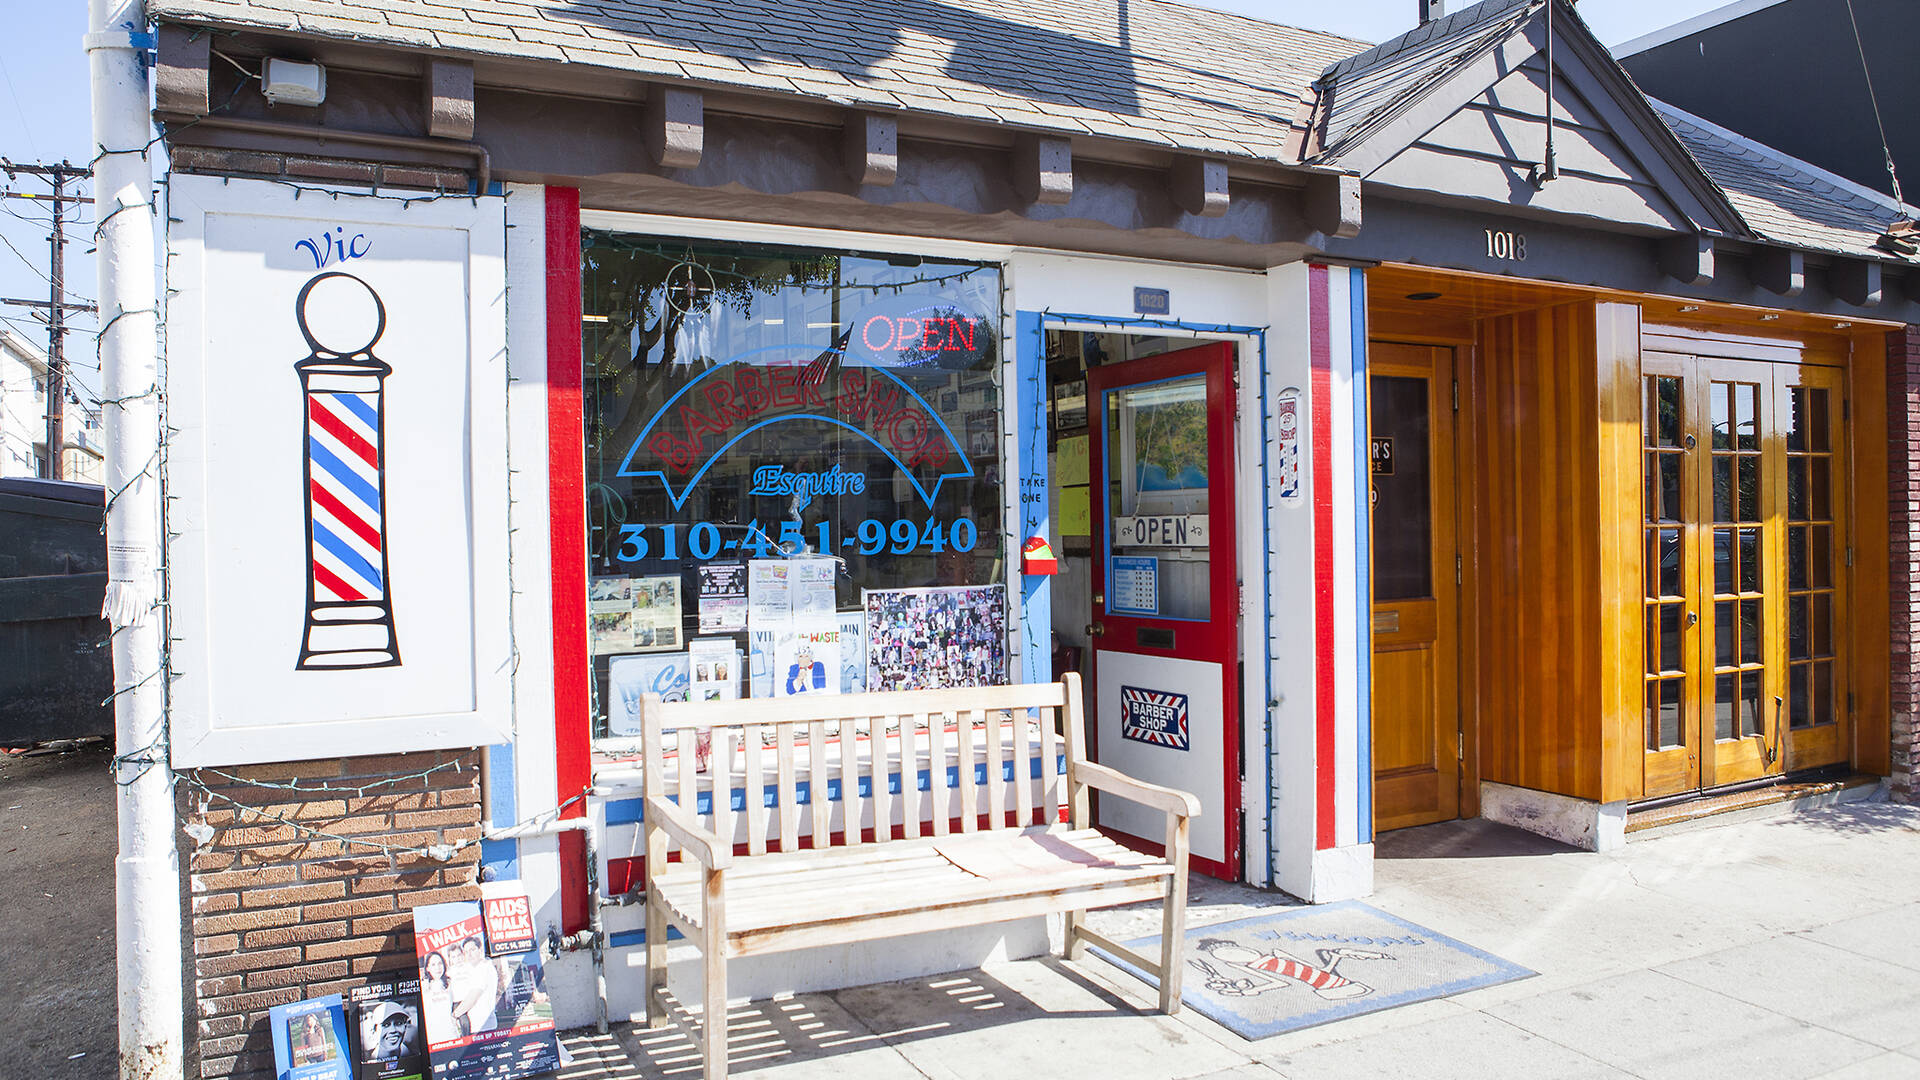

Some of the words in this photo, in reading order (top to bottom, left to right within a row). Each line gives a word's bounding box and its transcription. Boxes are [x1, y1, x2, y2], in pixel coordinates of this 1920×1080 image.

[295, 226, 372, 269] Vic
[1485, 229, 1527, 261] 1018
[1139, 294, 1165, 309] 1020
[862, 315, 978, 351] OPEN
[648, 360, 826, 475] BARBER
[835, 369, 949, 468] SHOP
[749, 464, 866, 512] Esquire
[1020, 478, 1045, 488] TAKE
[1021, 493, 1041, 503] ONE
[617, 516, 978, 562] 310-451-9940
[1135, 518, 1187, 545] OPEN
[810, 631, 839, 643] WASTE
[1132, 702, 1173, 720] BARBER
[1139, 716, 1167, 731] SHOP
[489, 897, 529, 918] AIDS
[490, 914, 531, 932] WALK
[421, 937, 430, 952] I
[492, 931, 504, 940] LOS
[1252, 929, 1425, 948] WELCOME
[351, 986, 371, 996] FIND
[371, 983, 393, 994] YOUR
[399, 980, 420, 988] FIGHT
